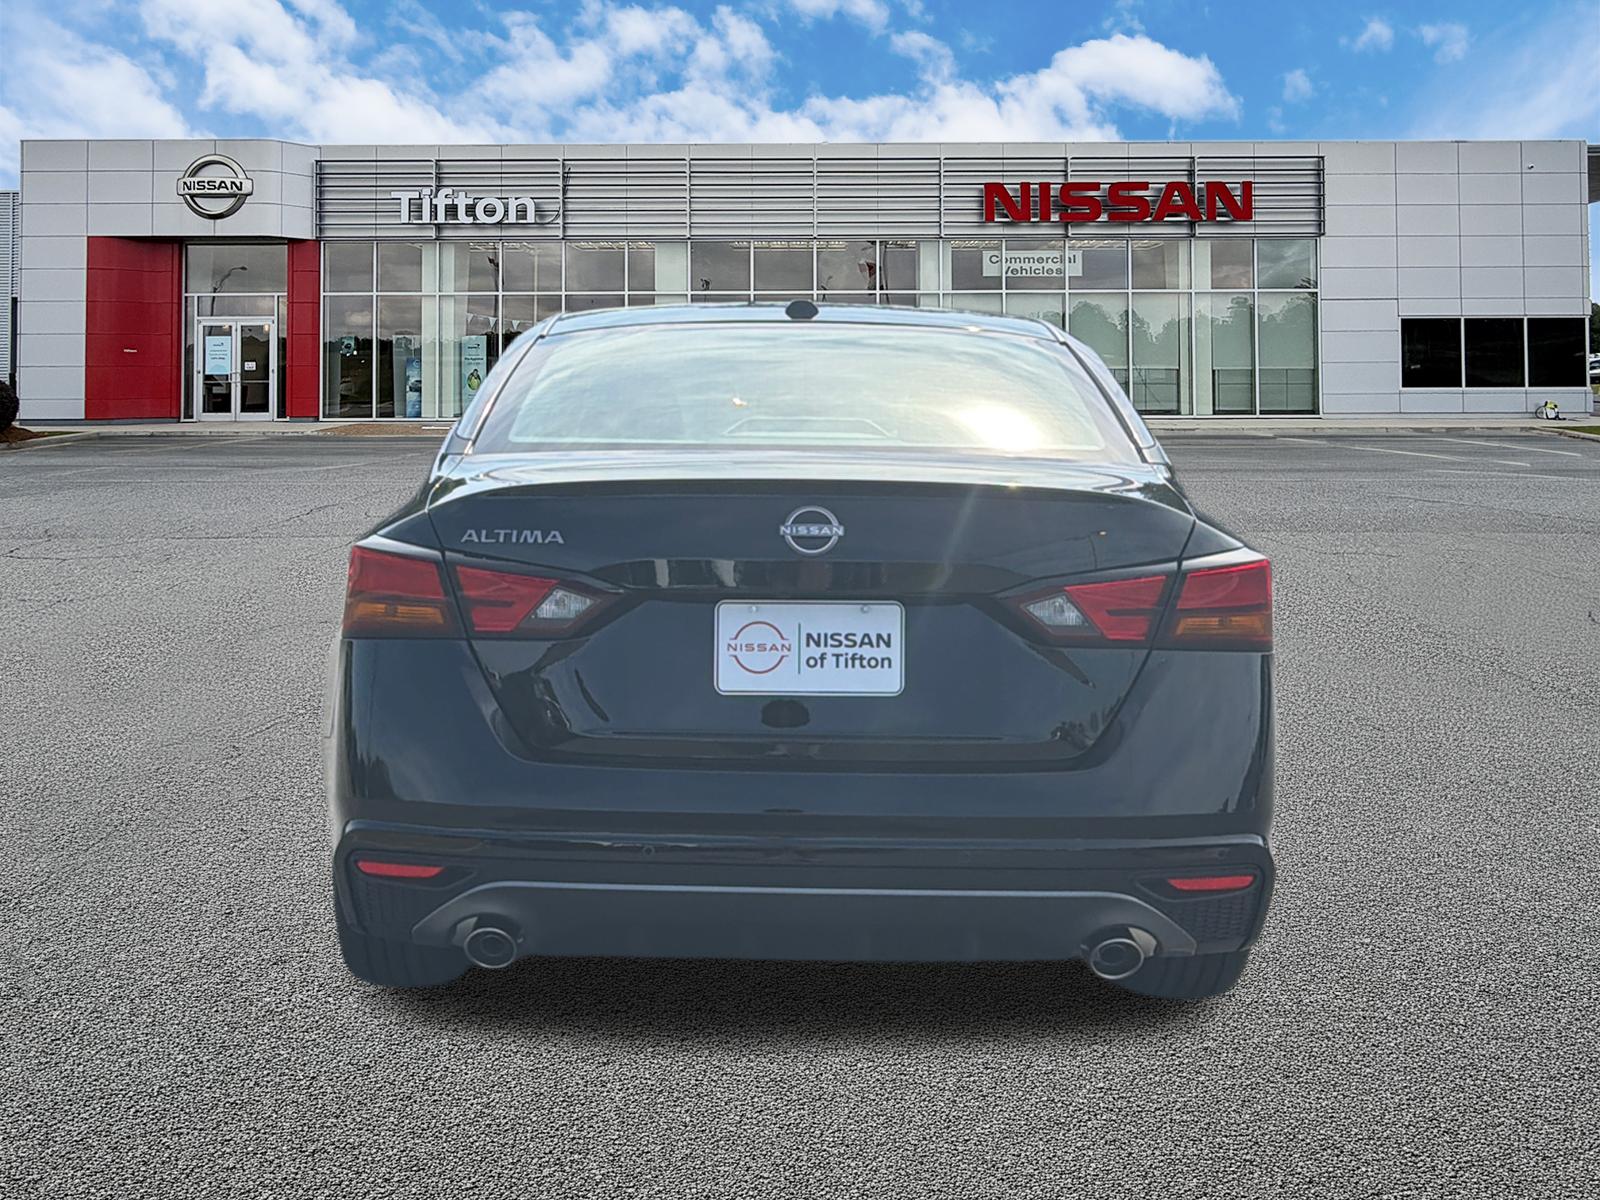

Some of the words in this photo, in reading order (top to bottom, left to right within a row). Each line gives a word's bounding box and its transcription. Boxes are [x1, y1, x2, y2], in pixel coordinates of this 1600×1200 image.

[182, 180, 244, 192] NISSAN
[390, 188, 536, 225] Tifton
[983, 180, 1254, 222] NISSAN
[460, 528, 566, 545] ALTIMA
[780, 525, 845, 537] NISSAN
[727, 642, 792, 653] NISSAN
[805, 632, 892, 649] NISSAN
[805, 652, 828, 669] of
[831, 652, 893, 669] Tifton
